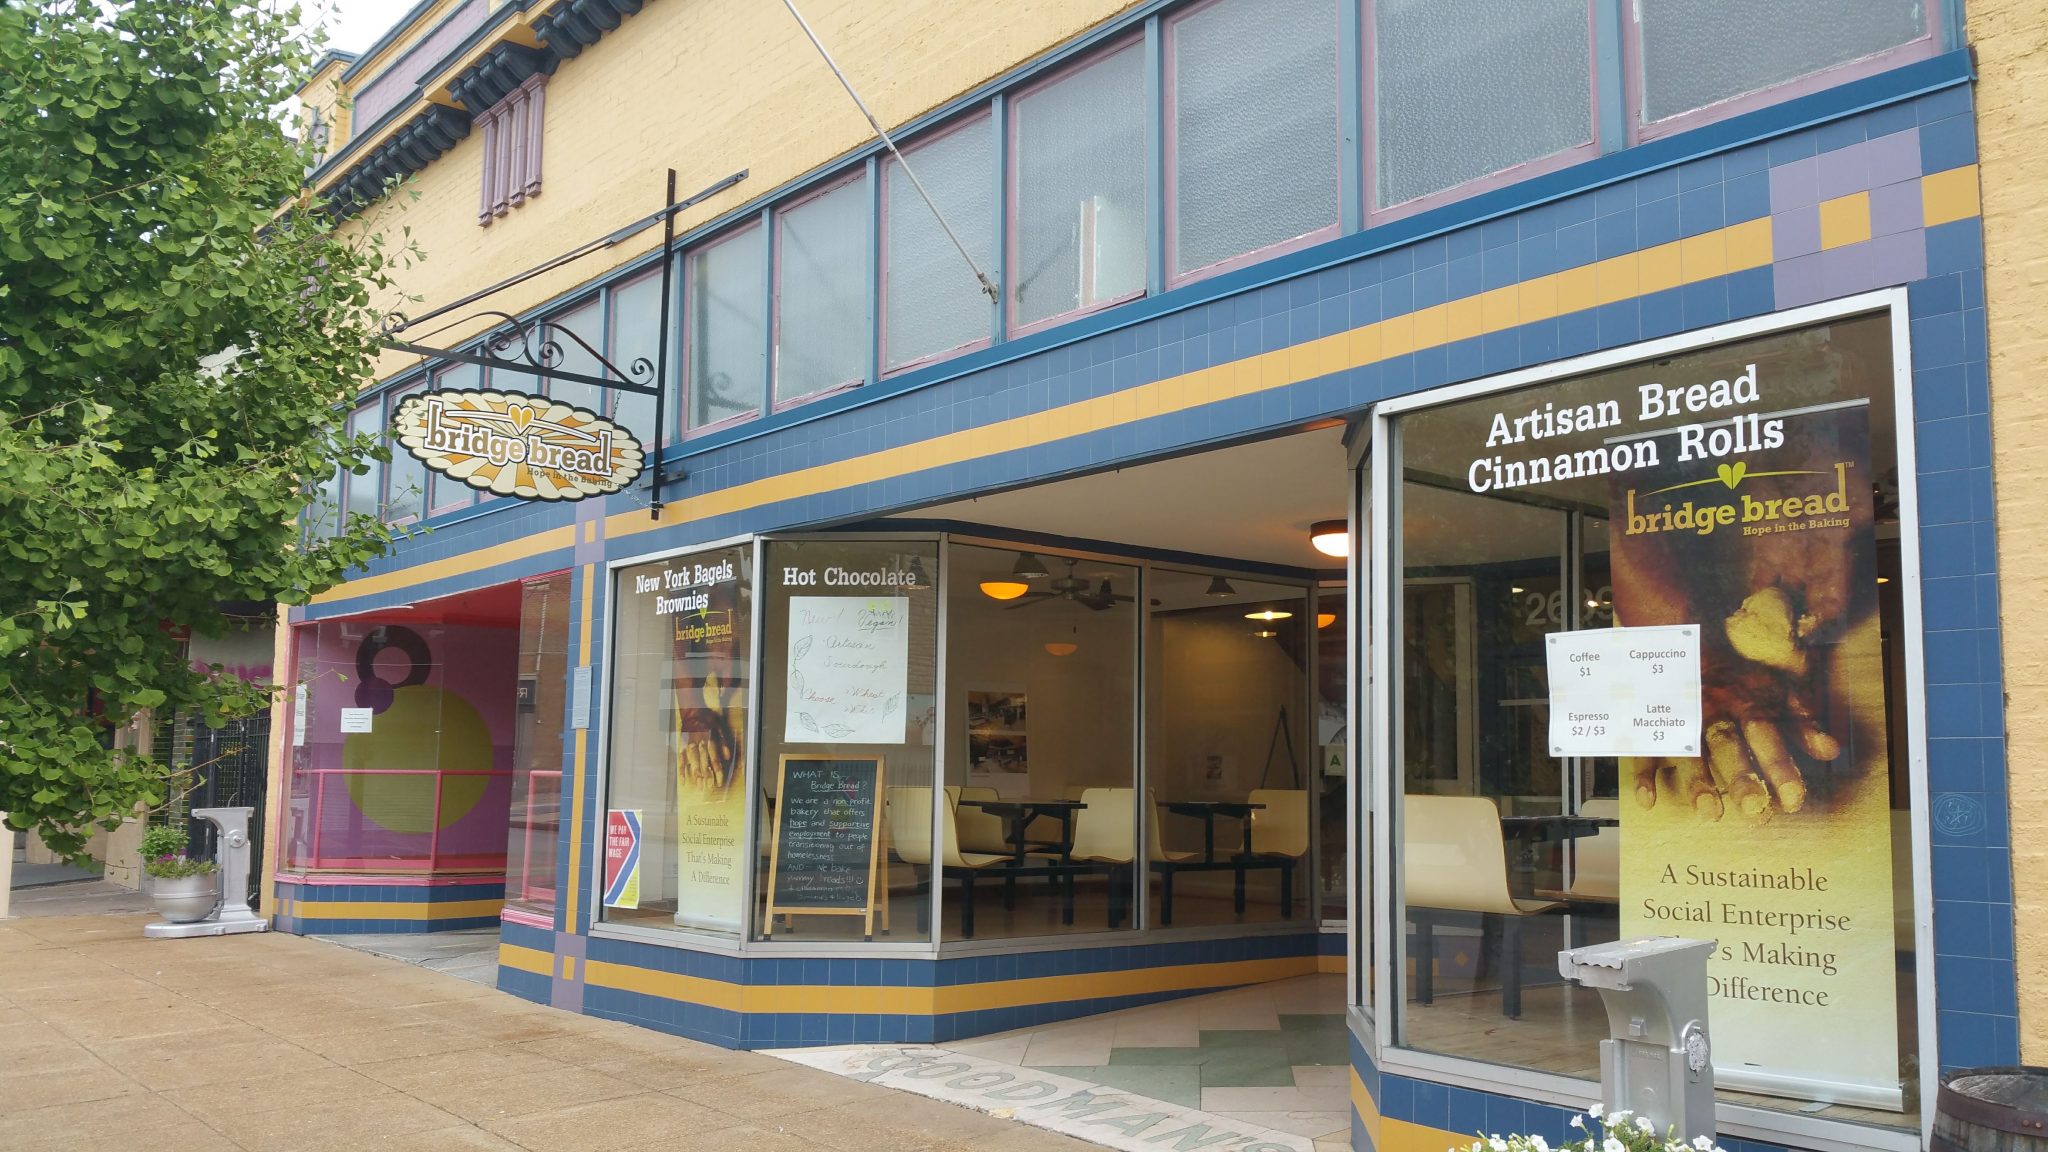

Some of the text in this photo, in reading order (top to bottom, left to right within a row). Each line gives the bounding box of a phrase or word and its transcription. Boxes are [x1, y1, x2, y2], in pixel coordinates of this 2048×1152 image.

[1485, 363, 1759, 448] Artisan Bread
[425, 402, 611, 475] bridge bread
[1468, 413, 1784, 493] Cinnamon Rolls
[527, 467, 550, 478] Hope
[553, 471, 562, 479] in
[563, 473, 579, 482] the
[1625, 489, 1735, 536] bridge
[1742, 463, 1849, 523] bread
[1742, 516, 1850, 537] Hope in the Baking
[635, 559, 733, 594] New York Bagels
[783, 567, 916, 585] Hot Chocolate
[656, 590, 709, 615] Brownies
[675, 609, 732, 643] bridge bread
[1569, 652, 1600, 663] Coffee
[1629, 648, 1686, 661] Cappuccino
[1579, 666, 1591, 677] $1
[1652, 663, 1664, 675] $3
[1646, 704, 1671, 714] Latte
[1568, 711, 1609, 723] Espresso
[1633, 717, 1686, 728] Macchiato
[1572, 725, 1583, 737] $2
[1593, 725, 1606, 736] $3
[1652, 730, 1665, 741] $3
[1330, 754, 1341, 766] A
[792, 770, 824, 779] WHAT
[810, 780, 834, 792] Bridge
[790, 807, 865, 818] bakery that offers
[686, 814, 729, 827] A Sustainable
[789, 818, 808, 828] hope
[609, 825, 627, 835] WE PAY
[788, 830, 868, 841] employment to people
[609, 836, 630, 847] THE FAIR
[681, 833, 735, 849] Social Enterprise
[608, 848, 622, 858] WAGE
[687, 851, 732, 869] That's Making
[691, 870, 730, 885] A Difference
[1660, 863, 1829, 891] A Sustainable
[1643, 898, 1852, 935] Social Enterprise
[1742, 941, 1838, 976] Making
